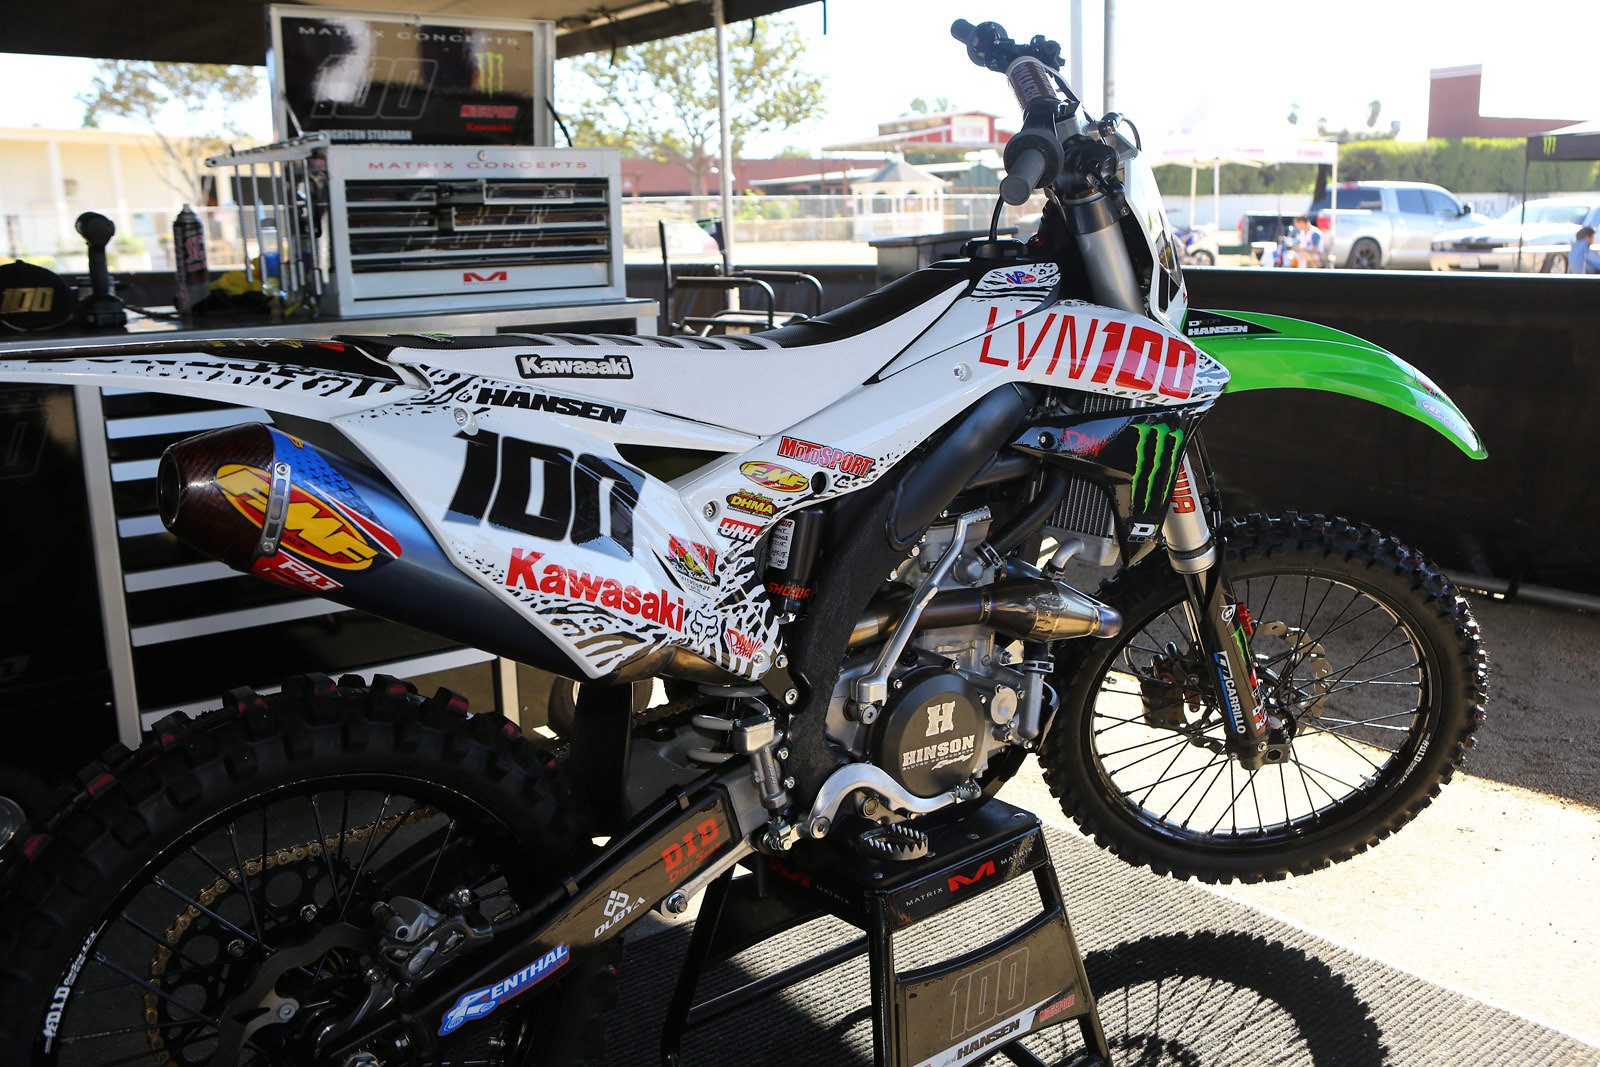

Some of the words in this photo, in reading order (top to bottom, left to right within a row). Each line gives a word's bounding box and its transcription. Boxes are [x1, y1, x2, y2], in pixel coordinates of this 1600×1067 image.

[298, 25, 386, 39] MATRIX
[396, 32, 520, 46] CONCEPTS
[366, 129, 413, 142] STEADMAN
[465, 122, 513, 133] Kawasaki
[368, 161, 455, 170] MATRIX
[466, 161, 588, 170] CONCEPTS
[1187, 325, 1249, 337] HANSEN
[520, 356, 633, 376] Kawasaki
[475, 386, 628, 425] HANSEN
[442, 426, 648, 558] 100
[742, 464, 810, 491] FMF
[731, 495, 773, 514] DHMA
[505, 547, 684, 632] Kawasaki
[768, 582, 812, 599] SHOWA
[1225, 680, 1247, 735] CARRILLO
[902, 734, 975, 768] HINSON
[905, 886, 945, 908] MATRIX
[1000, 846, 1034, 866] MATRIX
[593, 896, 647, 939] DUBYA
[447, 944, 569, 1021] RENTHAL
[950, 946, 1030, 1041] 100
[956, 1018, 1021, 1062] HANSEN
